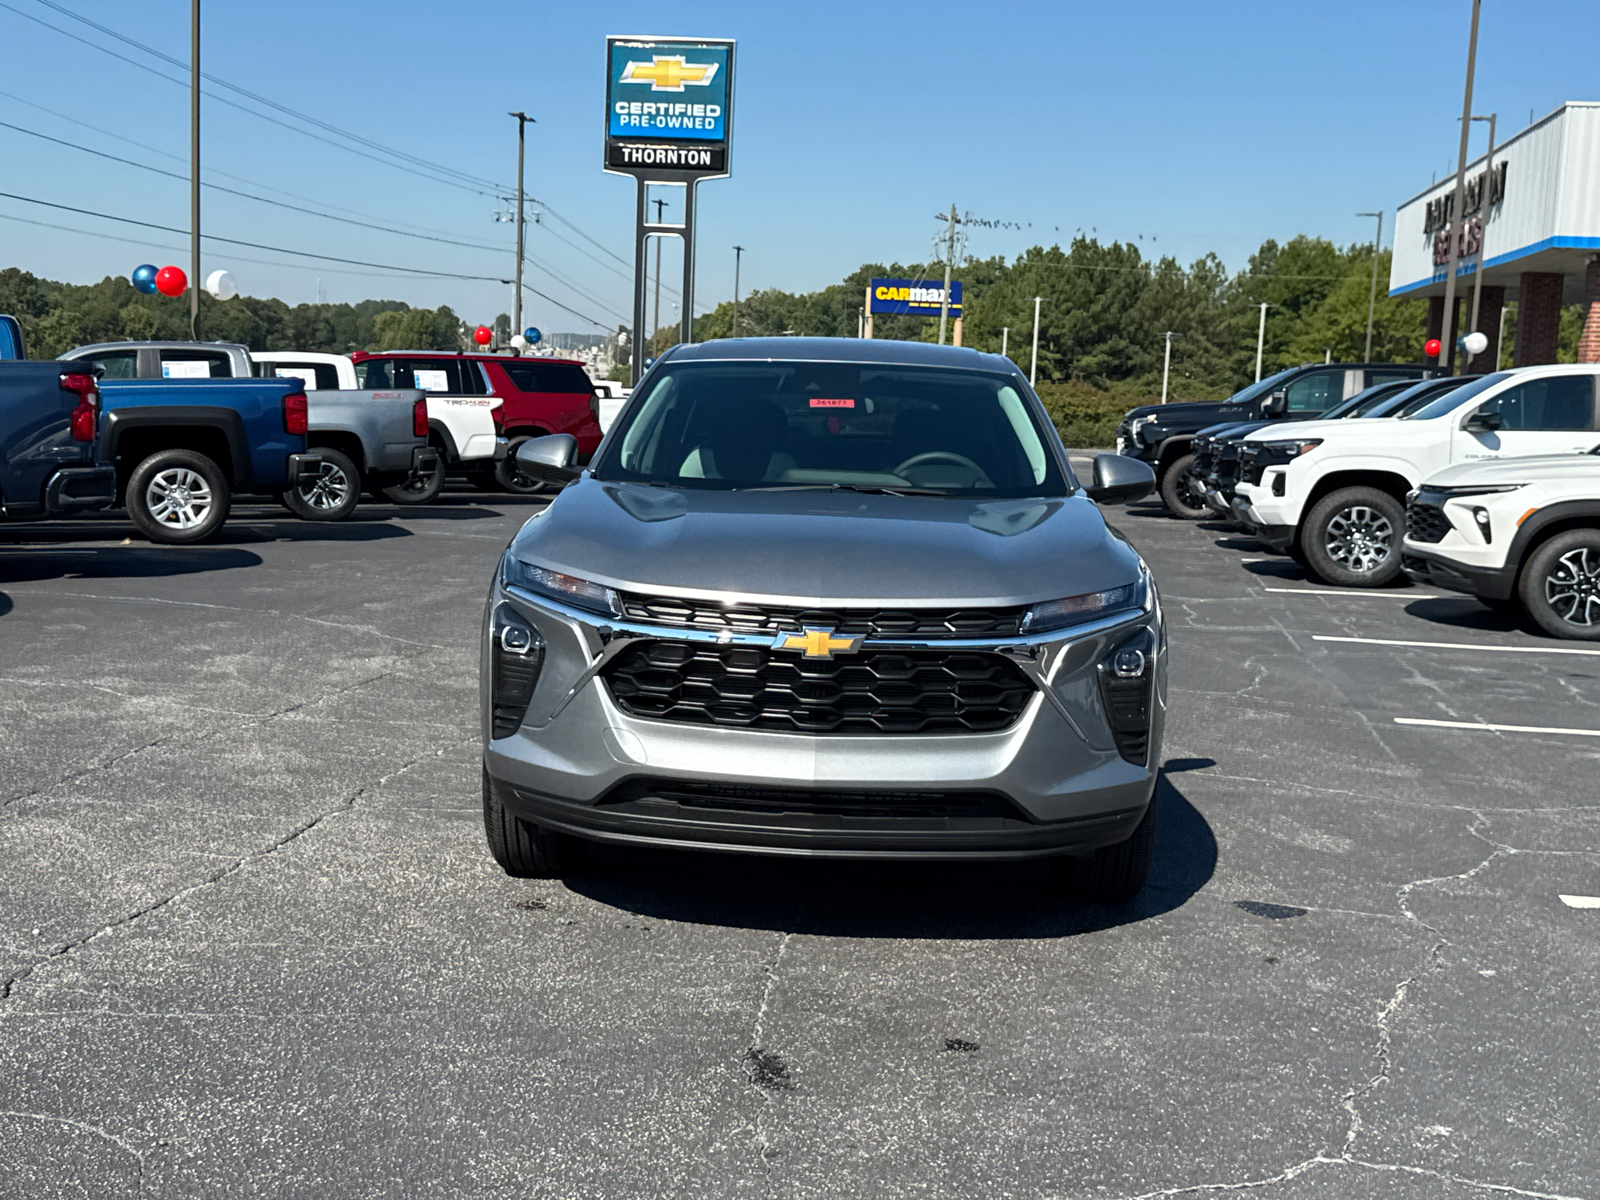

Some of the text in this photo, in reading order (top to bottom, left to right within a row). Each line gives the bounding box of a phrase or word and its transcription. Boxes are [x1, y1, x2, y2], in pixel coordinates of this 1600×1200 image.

[615, 101, 721, 117] CERTIFIED
[620, 115, 715, 130] PRE-OWNED
[622, 148, 711, 165] THORNTON
